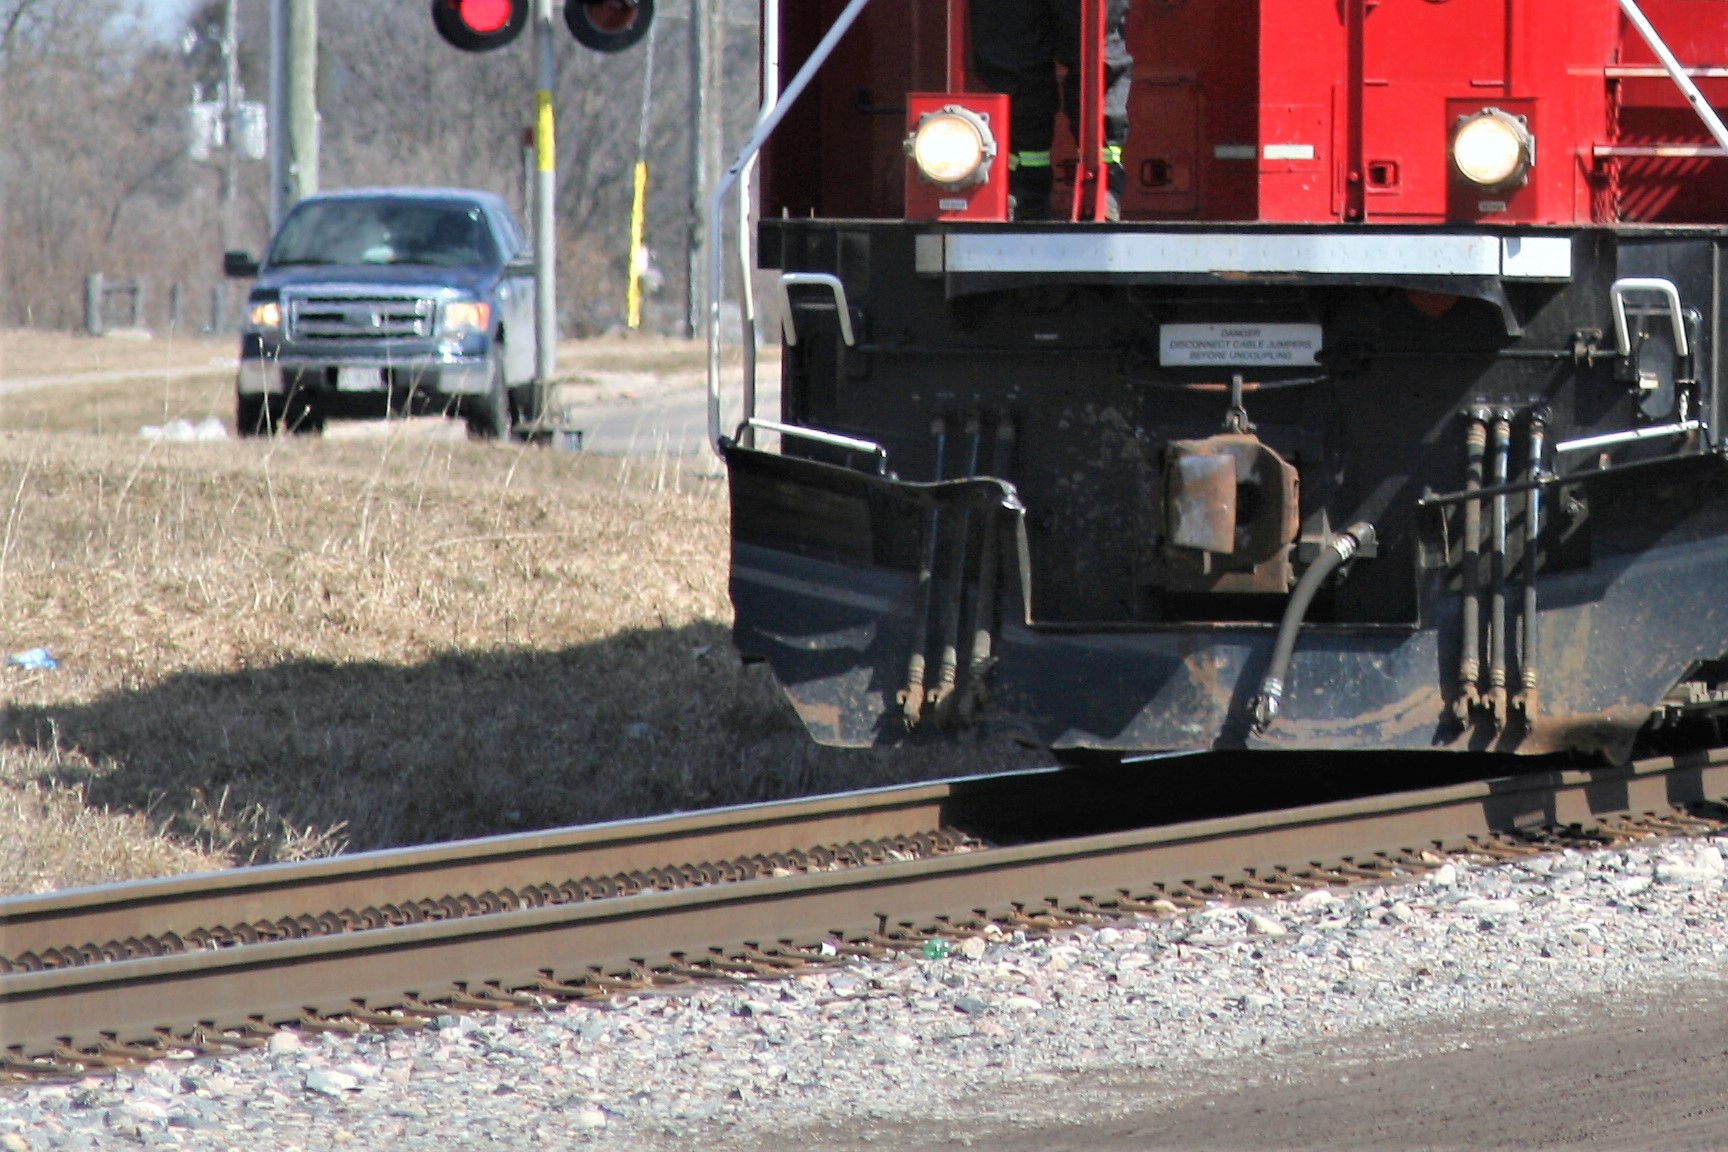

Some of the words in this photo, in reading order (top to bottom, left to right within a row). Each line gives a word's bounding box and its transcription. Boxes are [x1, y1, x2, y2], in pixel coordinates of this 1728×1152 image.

[1221, 328, 1261, 338] DANGER
[1170, 339, 1230, 349] DISCONNECT
[1232, 339, 1263, 349] CABLE
[1266, 339, 1312, 349] JUMPERS
[1189, 351, 1226, 360] BEFORE
[1229, 351, 1292, 360] UNCOUPLING
